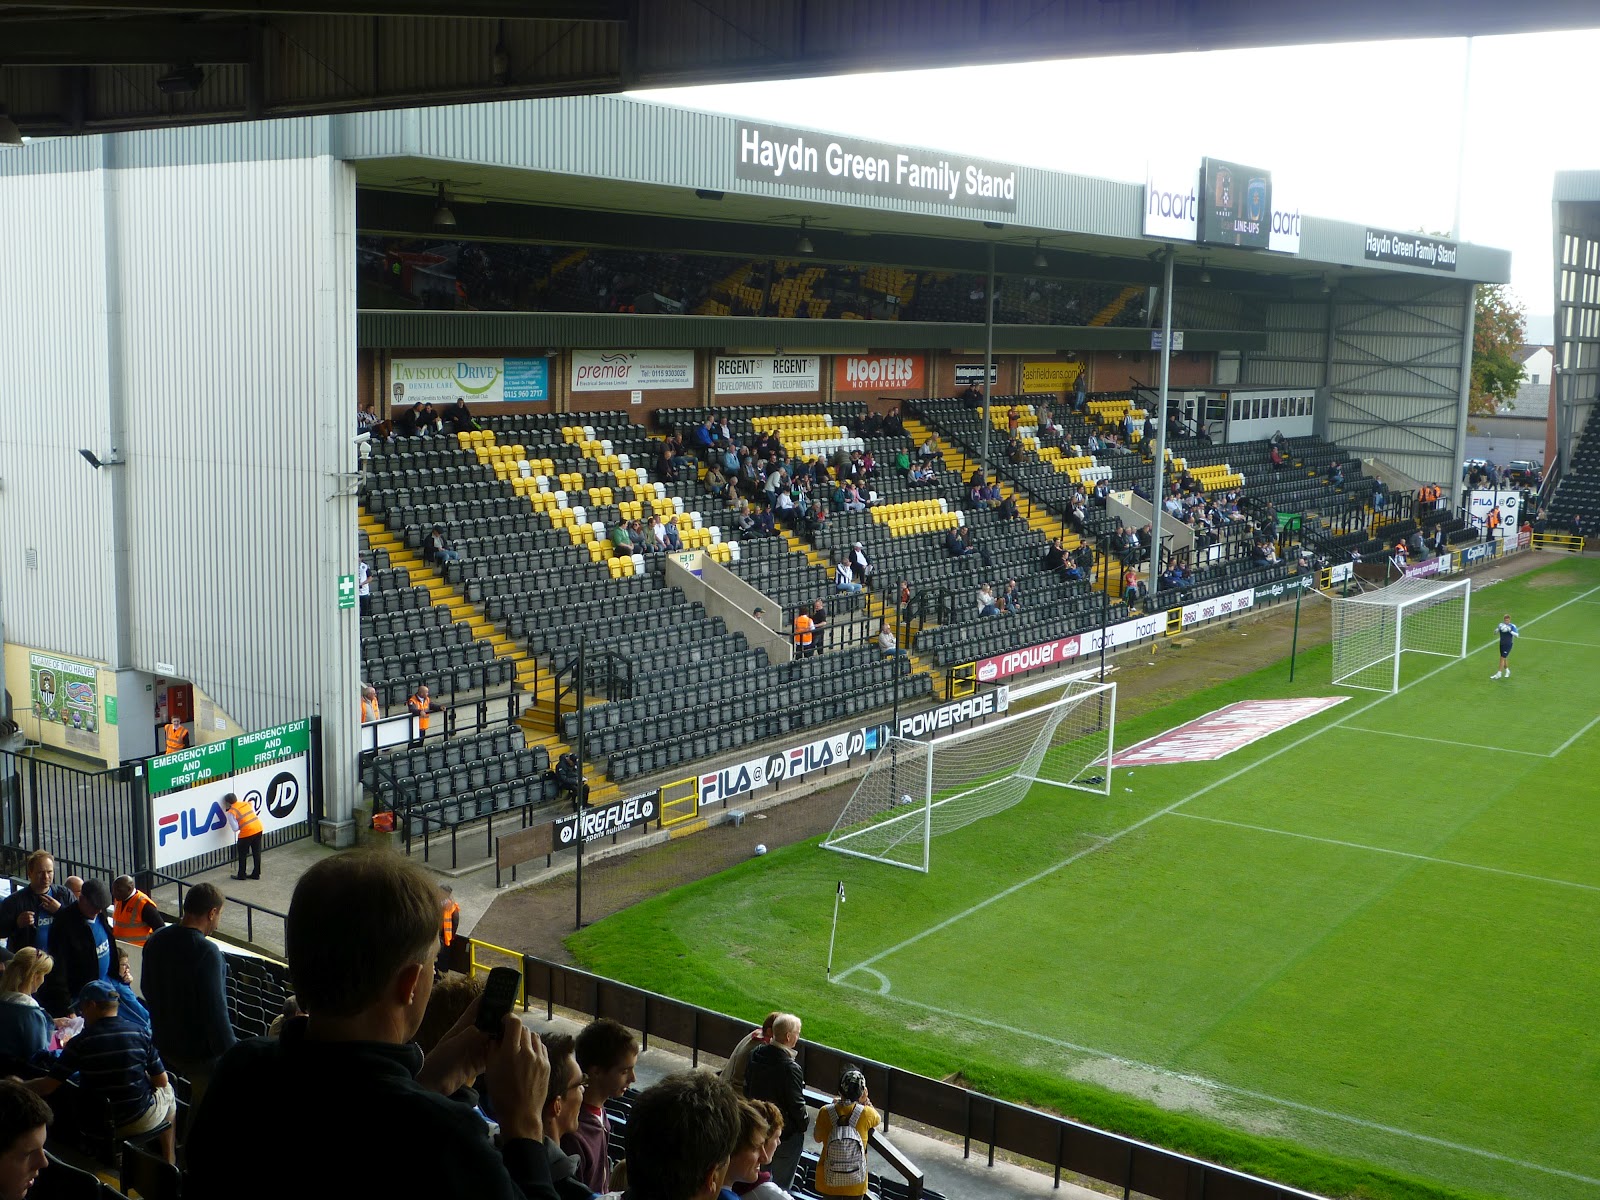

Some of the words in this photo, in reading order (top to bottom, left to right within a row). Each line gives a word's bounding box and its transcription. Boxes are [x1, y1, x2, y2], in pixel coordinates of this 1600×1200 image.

[741, 128, 818, 176] Haydn
[826, 142, 890, 182] Green
[896, 154, 960, 199] Family
[965, 166, 1015, 200] Stand
[1150, 177, 1196, 221] haart
[1366, 232, 1390, 257] Haydn
[1392, 236, 1413, 257] Green
[1414, 240, 1437, 265] Family
[1438, 244, 1456, 264] Stand
[576, 361, 632, 386] premier
[718, 360, 755, 374] REGENT
[757, 360, 763, 368] ST
[773, 360, 807, 373] REGENT
[808, 359, 814, 367] ST
[847, 358, 912, 381] HOOTERS
[1026, 368, 1077, 379] ashfieldvans.com
[718, 381, 762, 391] DEVELOPMENTS
[772, 380, 814, 389] DEVELOPMENTS
[1136, 618, 1156, 638] haart
[37, 657, 52, 666] GAME
[61, 662, 72, 672] TWO
[74, 665, 94, 677] HALVES
[1002, 643, 1058, 674] npower
[900, 693, 993, 738] POWERADE
[238, 726, 286, 746] EMERGENCY
[289, 721, 304, 732] EXIT
[265, 738, 281, 750] AND
[154, 749, 206, 768] EMERGENCY
[208, 742, 226, 754] EXIT
[254, 749, 276, 763] FIRST
[278, 746, 291, 756] AID
[790, 741, 833, 776] FILA
[835, 742, 843, 756] @
[848, 732, 864, 755] JD
[182, 760, 200, 772] AND
[171, 772, 195, 787] FIRST
[198, 768, 211, 779] AID
[702, 766, 751, 803] FILA
[753, 767, 762, 781] @
[768, 757, 784, 780] JD
[159, 801, 227, 846] FILA
[270, 780, 296, 811] JD
[586, 831, 605, 843] sports
